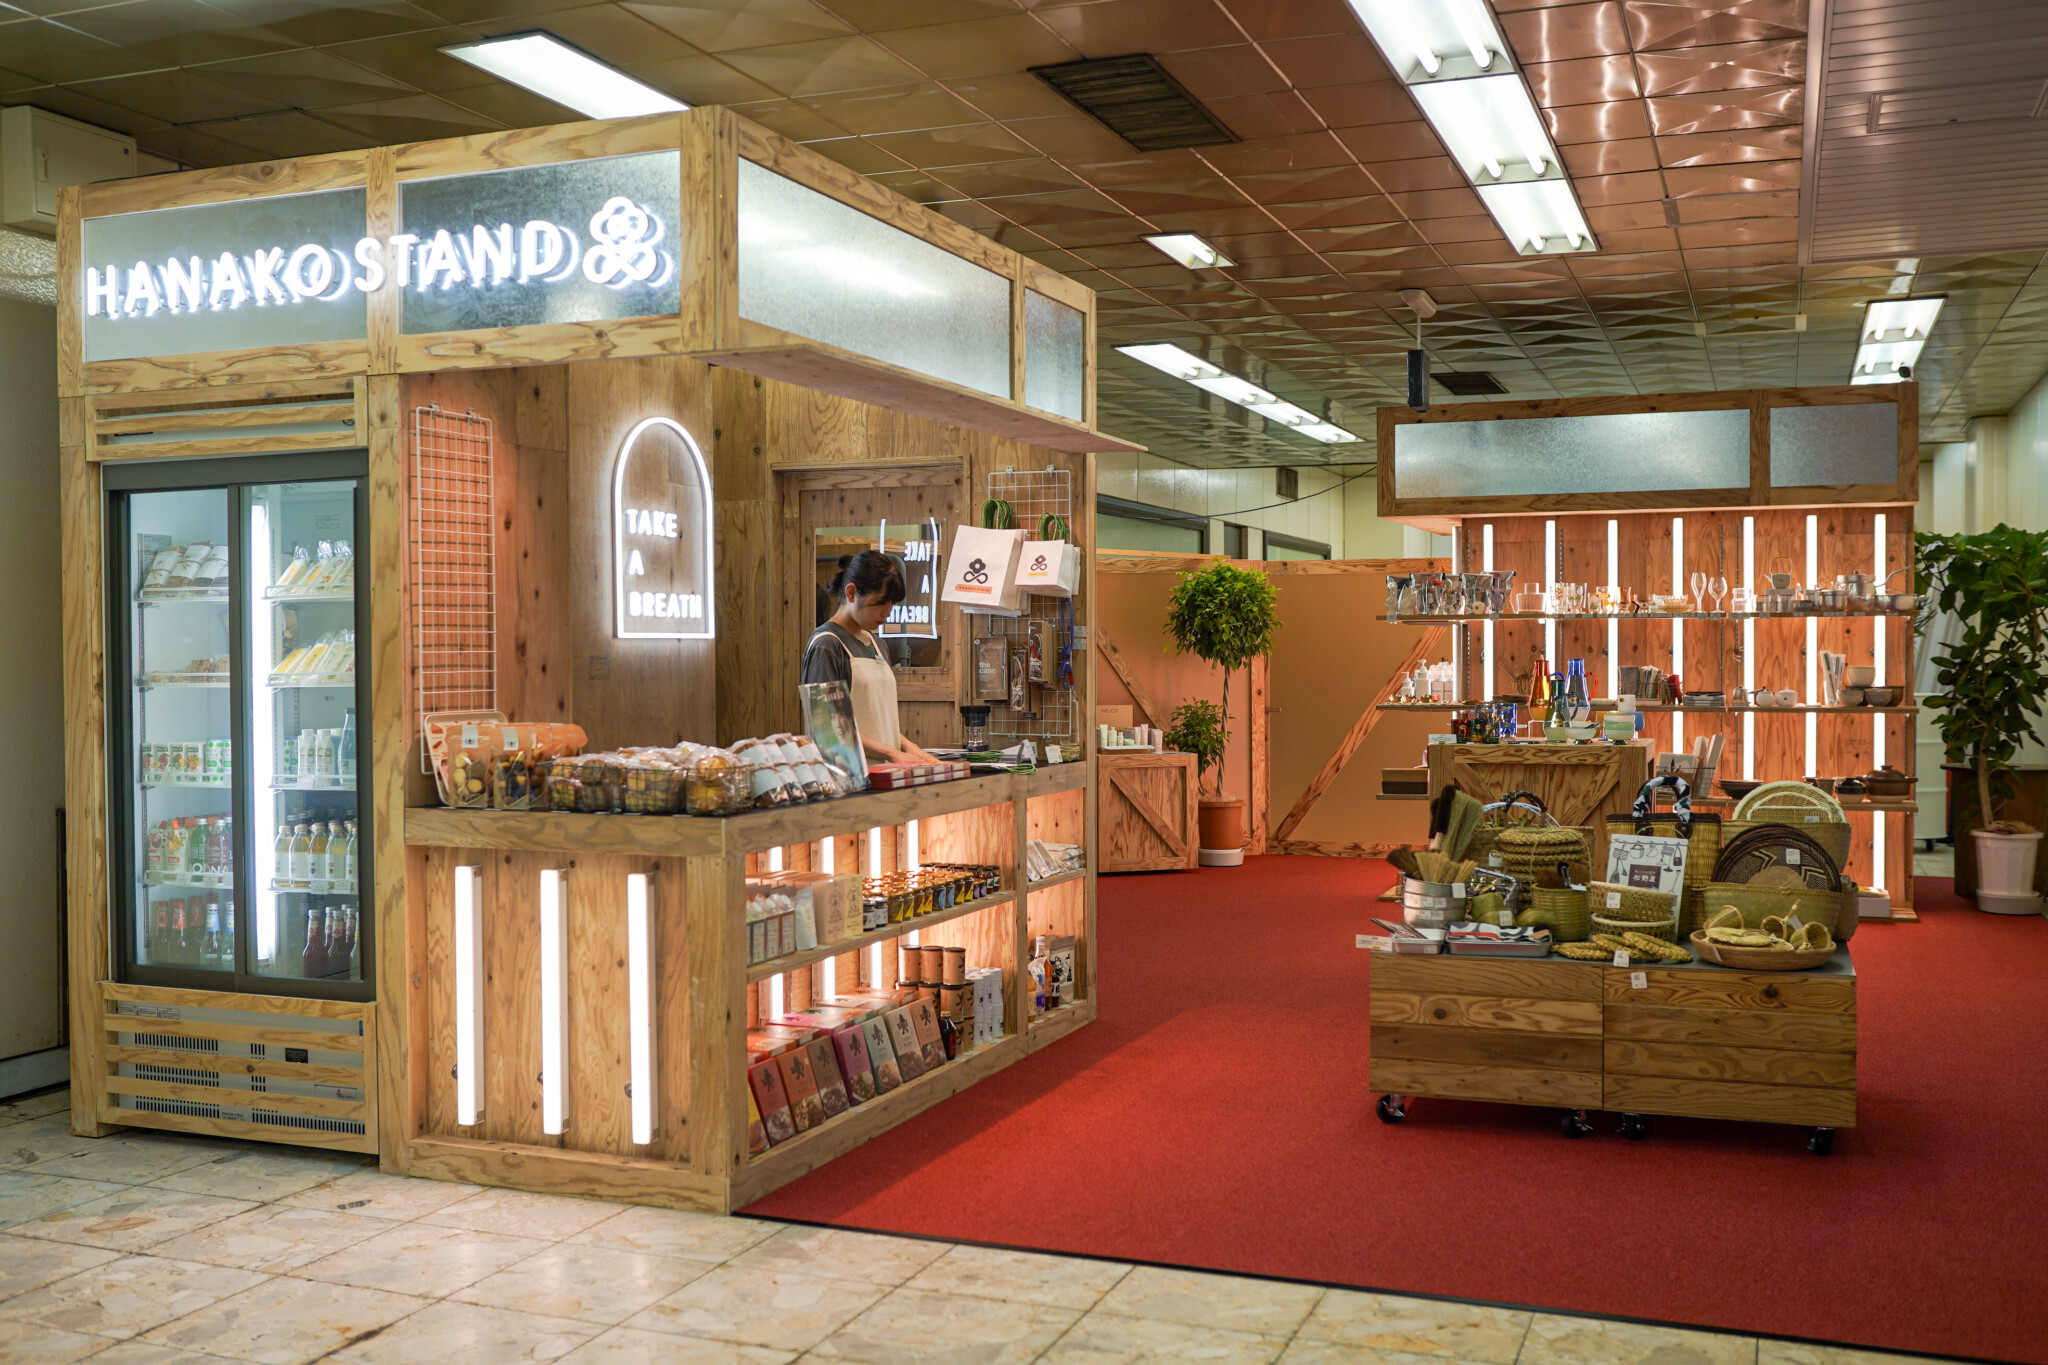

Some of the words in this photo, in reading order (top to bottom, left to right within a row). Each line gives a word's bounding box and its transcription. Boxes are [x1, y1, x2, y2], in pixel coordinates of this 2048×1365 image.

[87, 244, 334, 316] HANAKO
[354, 220, 564, 292] STAND
[626, 509, 678, 538] TAKE
[628, 549, 645, 576] A
[629, 591, 702, 619] BREATH
